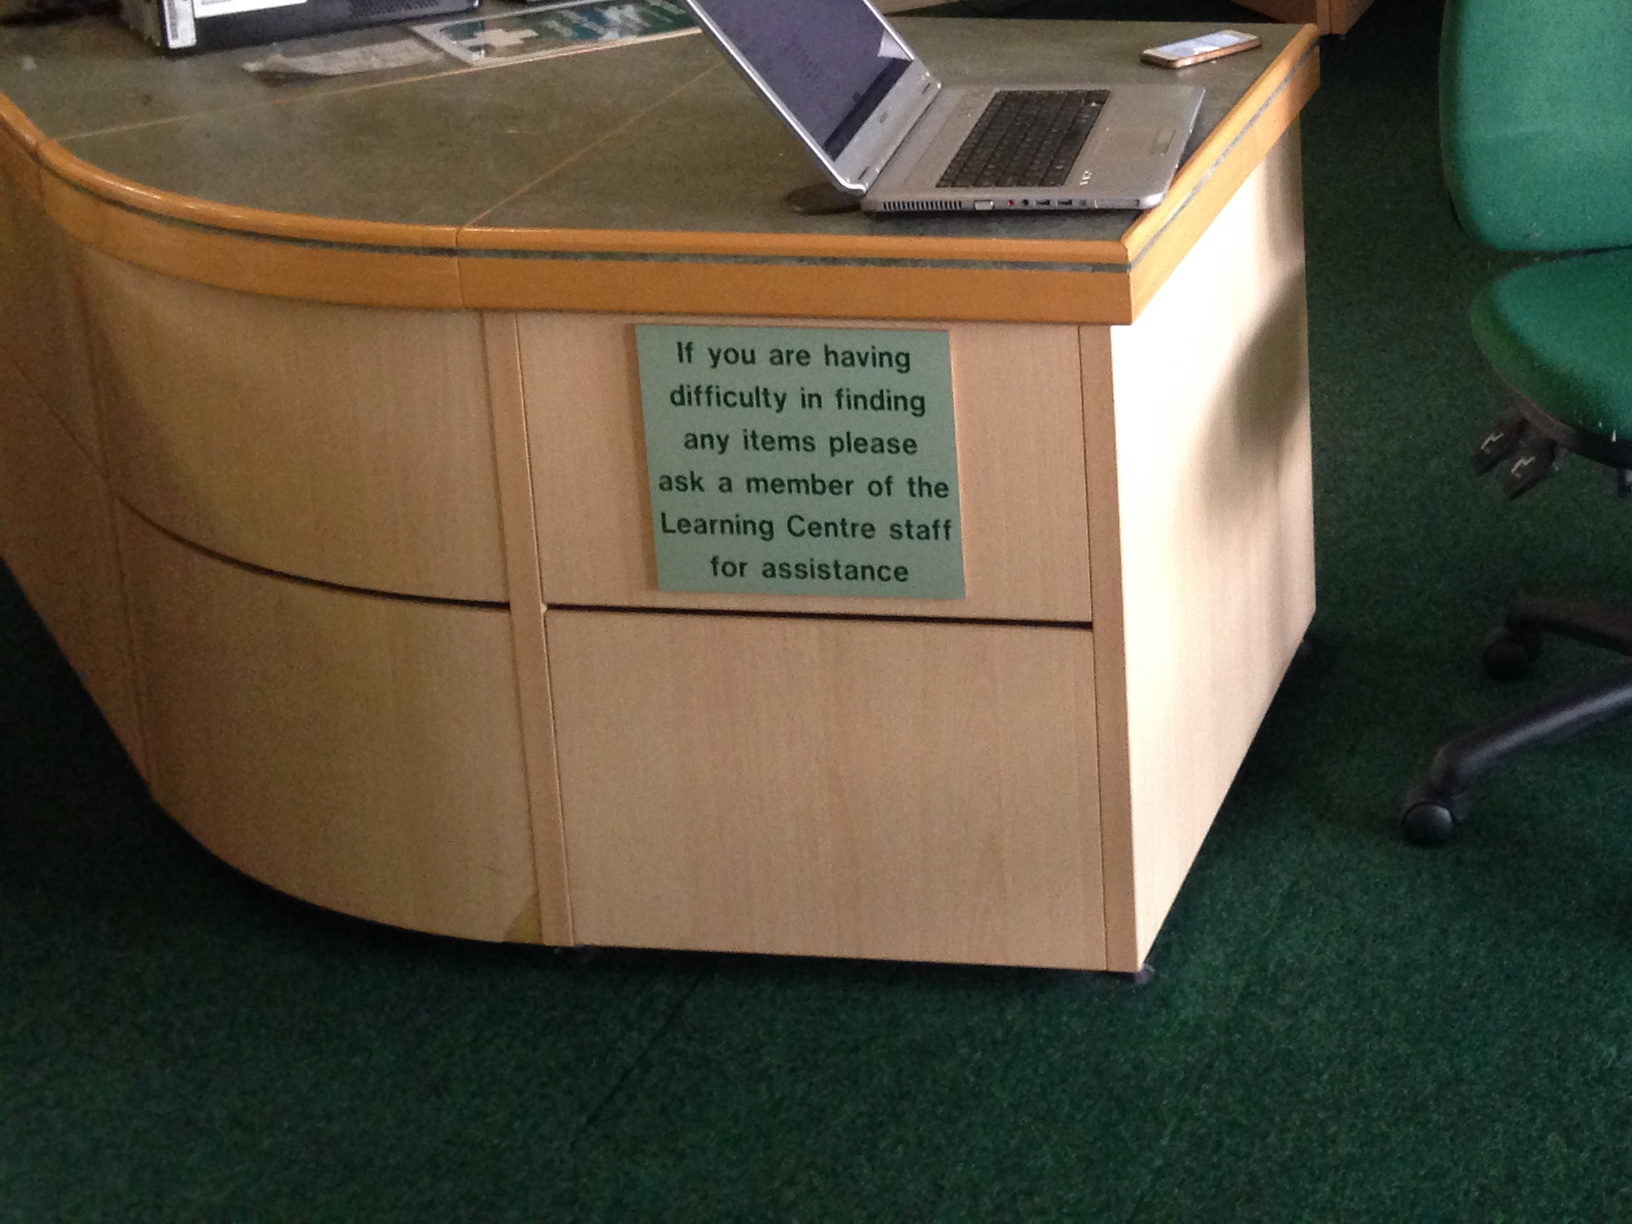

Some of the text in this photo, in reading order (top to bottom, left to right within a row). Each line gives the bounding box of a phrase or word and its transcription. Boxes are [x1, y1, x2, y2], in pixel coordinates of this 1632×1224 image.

[677, 341, 910, 374] If you are having
[670, 384, 925, 417] difficulty in finding
[684, 429, 917, 457] any items please
[659, 471, 949, 498] ask a member of the
[661, 512, 951, 542] Learning Centre staff
[710, 556, 908, 582] for assistance
